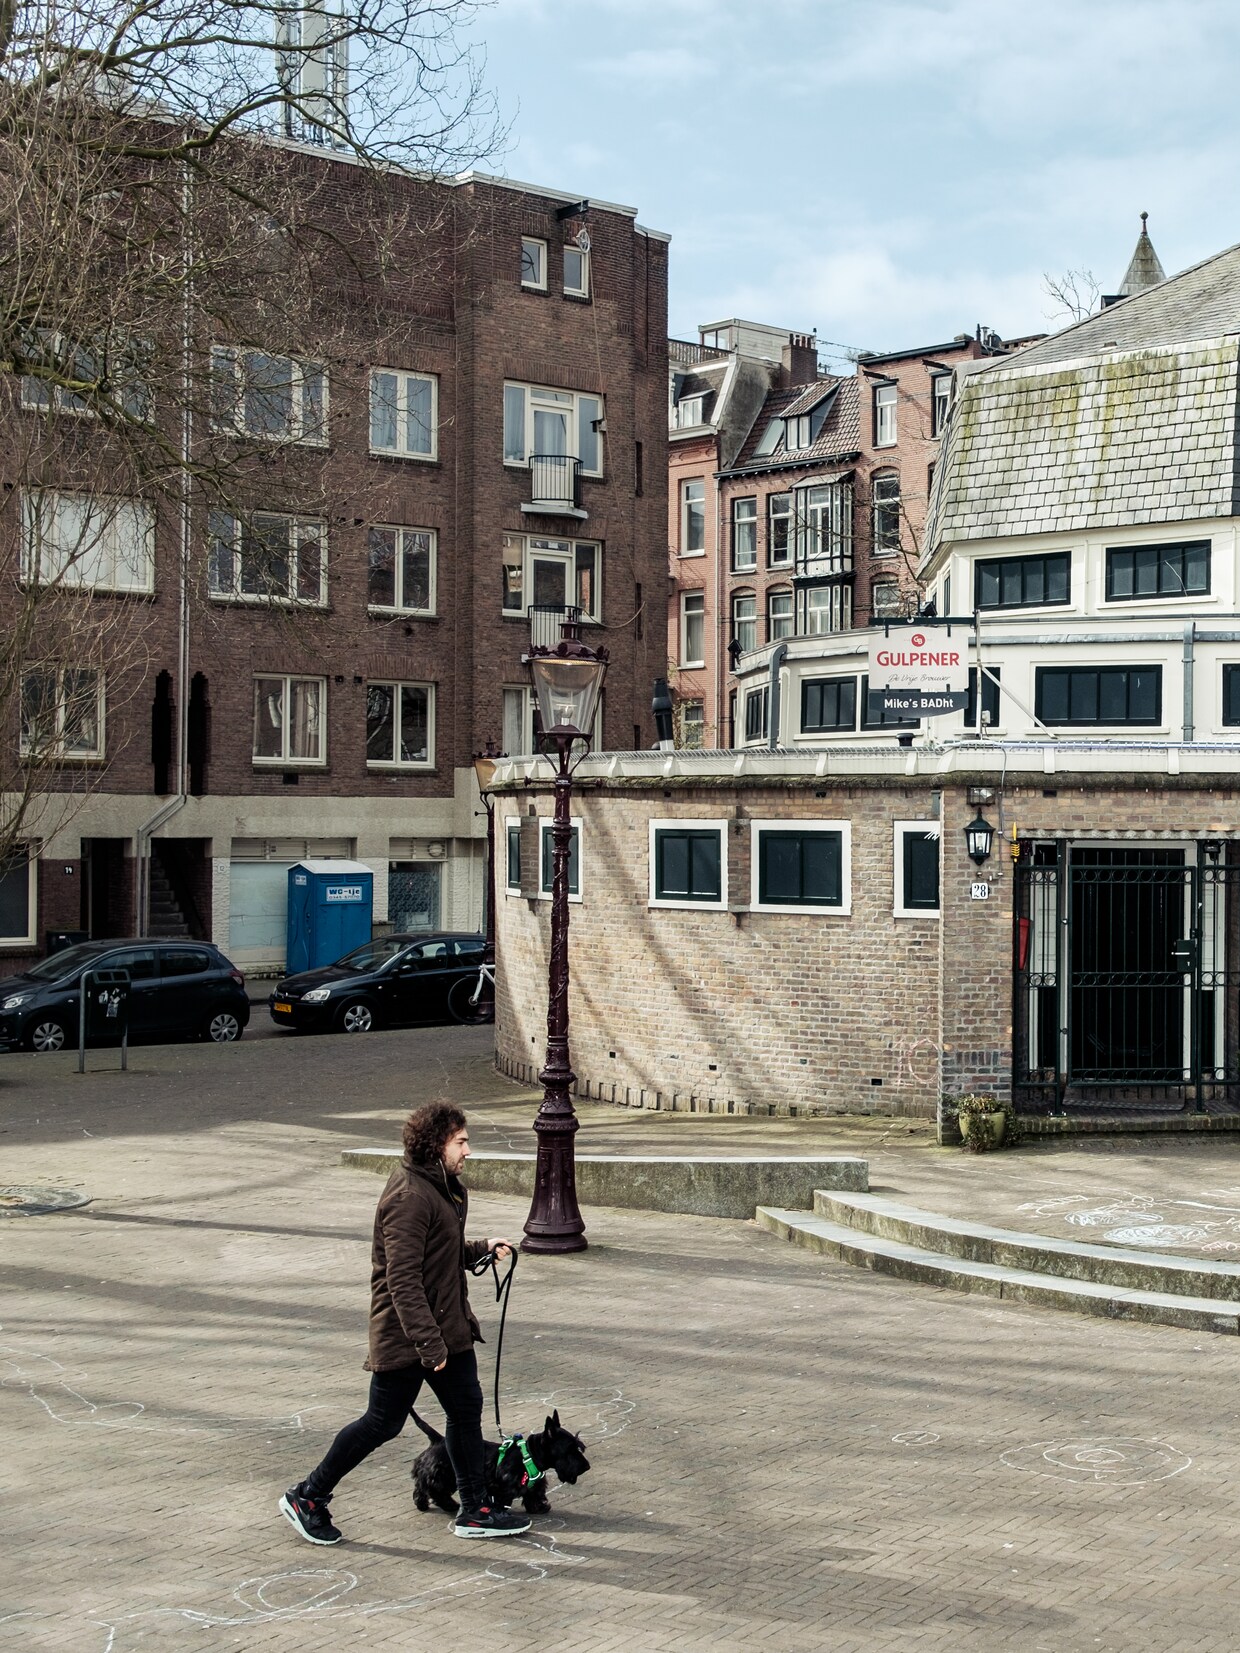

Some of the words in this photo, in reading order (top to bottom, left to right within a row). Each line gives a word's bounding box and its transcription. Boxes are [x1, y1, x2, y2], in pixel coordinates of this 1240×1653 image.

[877, 651, 959, 666] GULPENER
[888, 674, 898, 682] De
[920, 674, 951, 682] Brouwer
[884, 698, 918, 708] Mike's
[920, 698, 953, 708] BADht
[329, 888, 360, 896] WC-tje
[974, 884, 986, 897] 28
